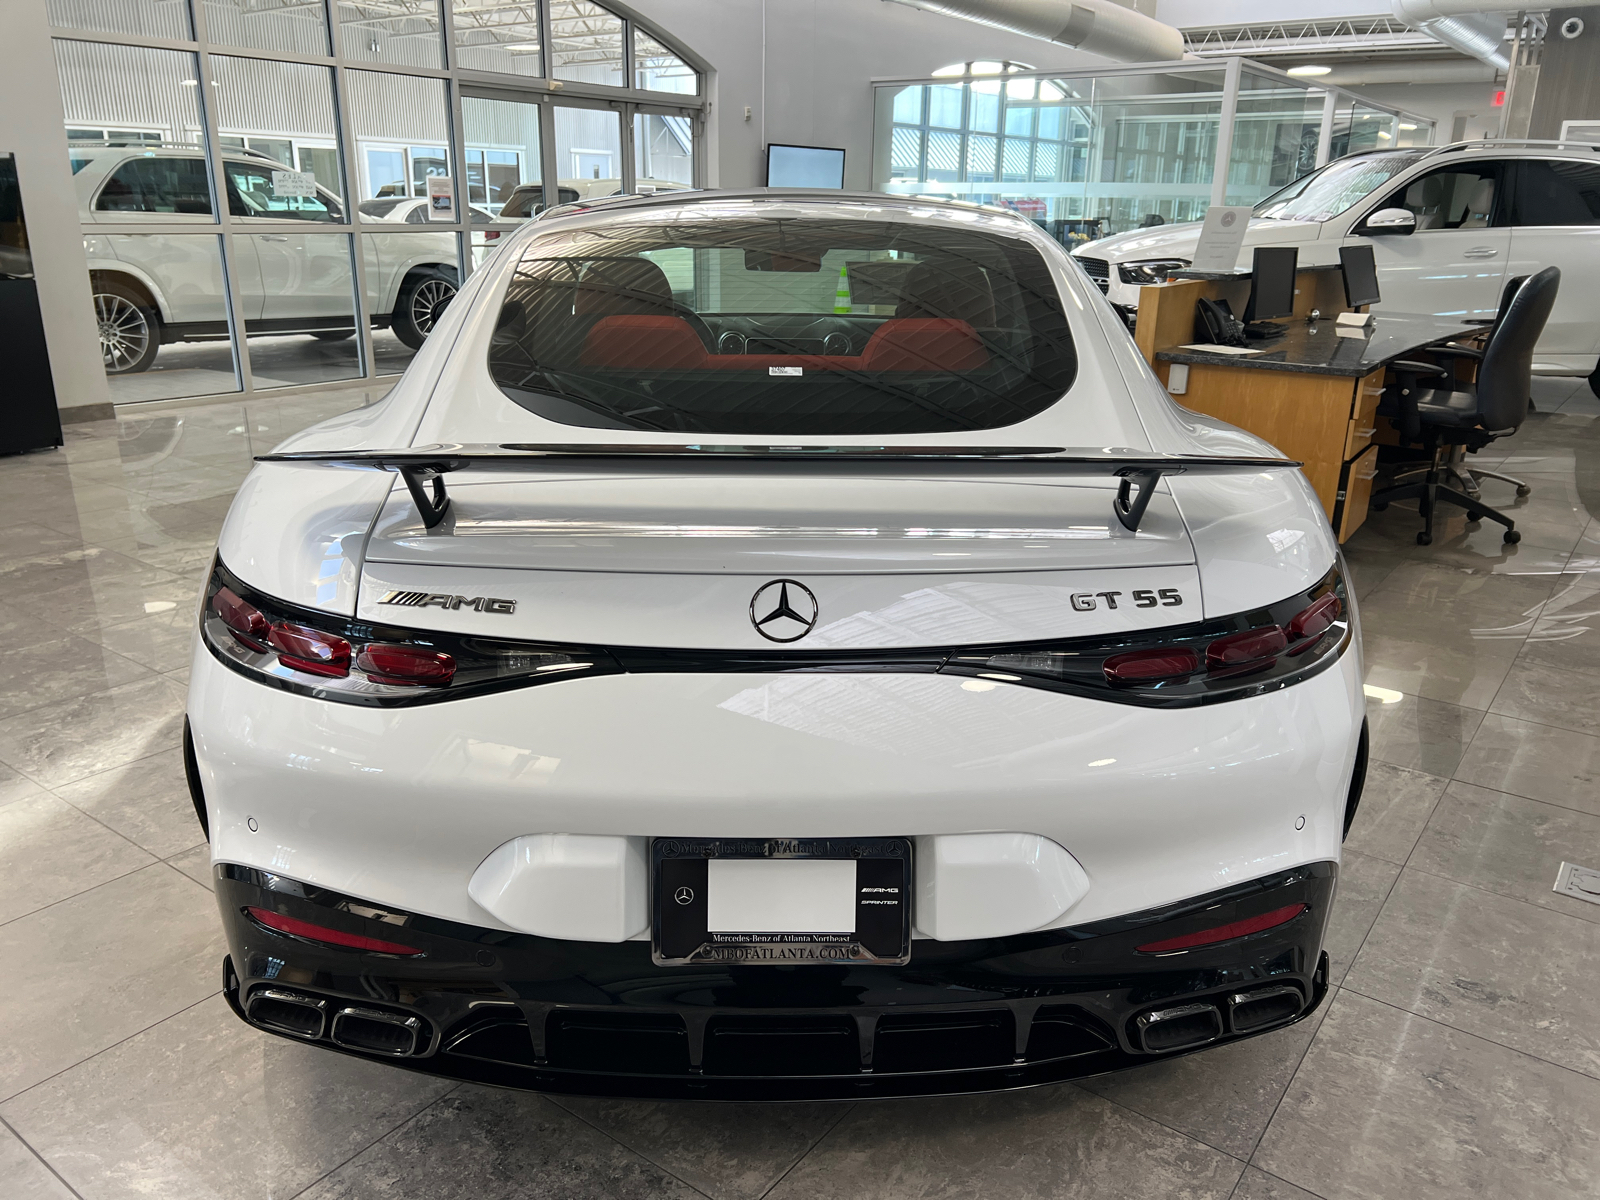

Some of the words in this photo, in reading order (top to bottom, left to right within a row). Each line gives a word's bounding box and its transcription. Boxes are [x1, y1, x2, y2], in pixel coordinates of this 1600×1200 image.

[417, 593, 516, 614] AMG
[1070, 591, 1122, 612] GT
[1132, 588, 1183, 608] 55
[713, 934, 771, 943] Mercedes-Benz
[772, 934, 782, 943] of
[782, 934, 811, 943] Atlanta
[812, 934, 850, 943] Northeast
[712, 947, 850, 959] MBOFATLANTA.COM
